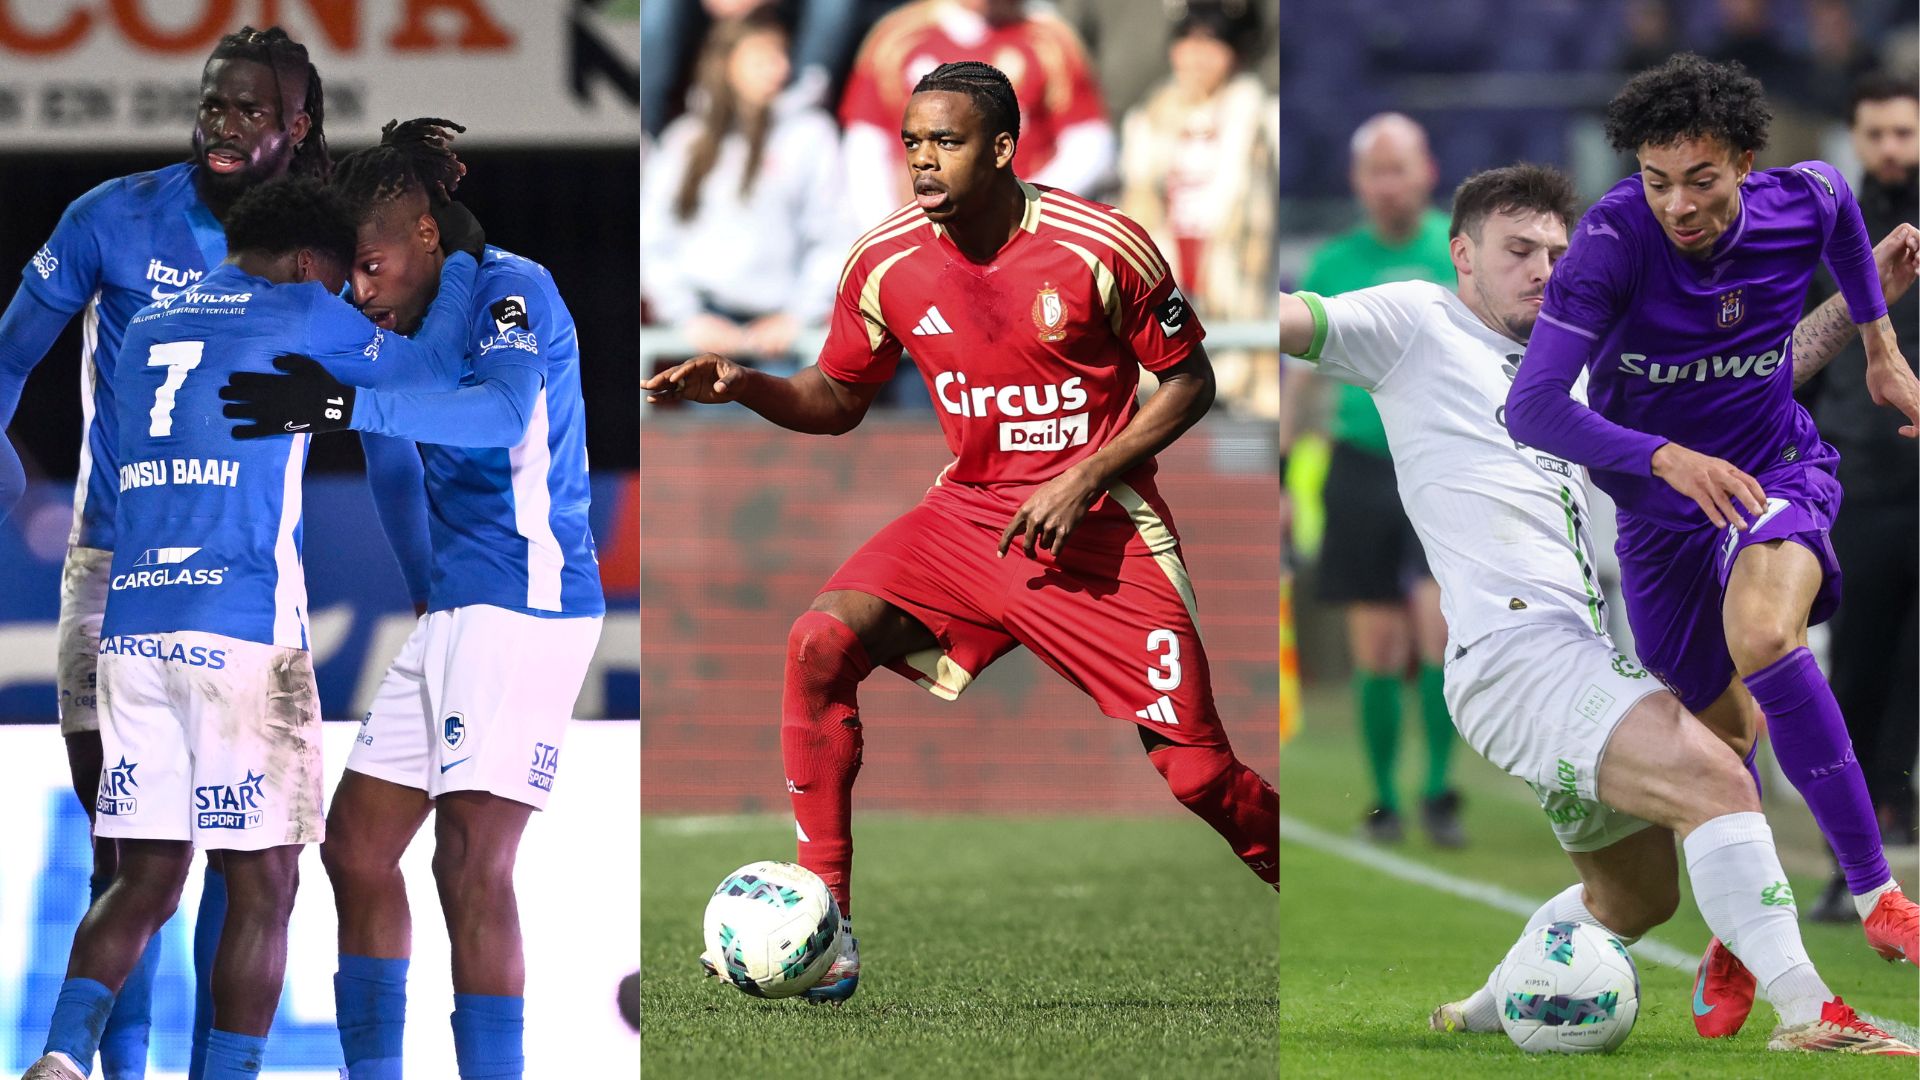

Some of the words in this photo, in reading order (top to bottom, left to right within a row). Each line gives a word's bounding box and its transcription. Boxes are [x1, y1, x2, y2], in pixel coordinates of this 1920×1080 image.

[146, 259, 188, 288] itzu
[185, 292, 253, 304] WILMS
[147, 340, 204, 437] 7
[935, 371, 1088, 418] Circus
[324, 397, 344, 420] 18
[1011, 424, 1078, 449] Daily
[172, 458, 240, 487] BAAH
[111, 568, 223, 591] CARGLASS
[1146, 628, 1182, 691] 3
[118, 801, 133, 812] TV
[195, 785, 258, 811] STAR
[200, 815, 242, 828] SPORT
[248, 815, 260, 825] TV
[1525, 978, 1549, 987] KIPSTA
